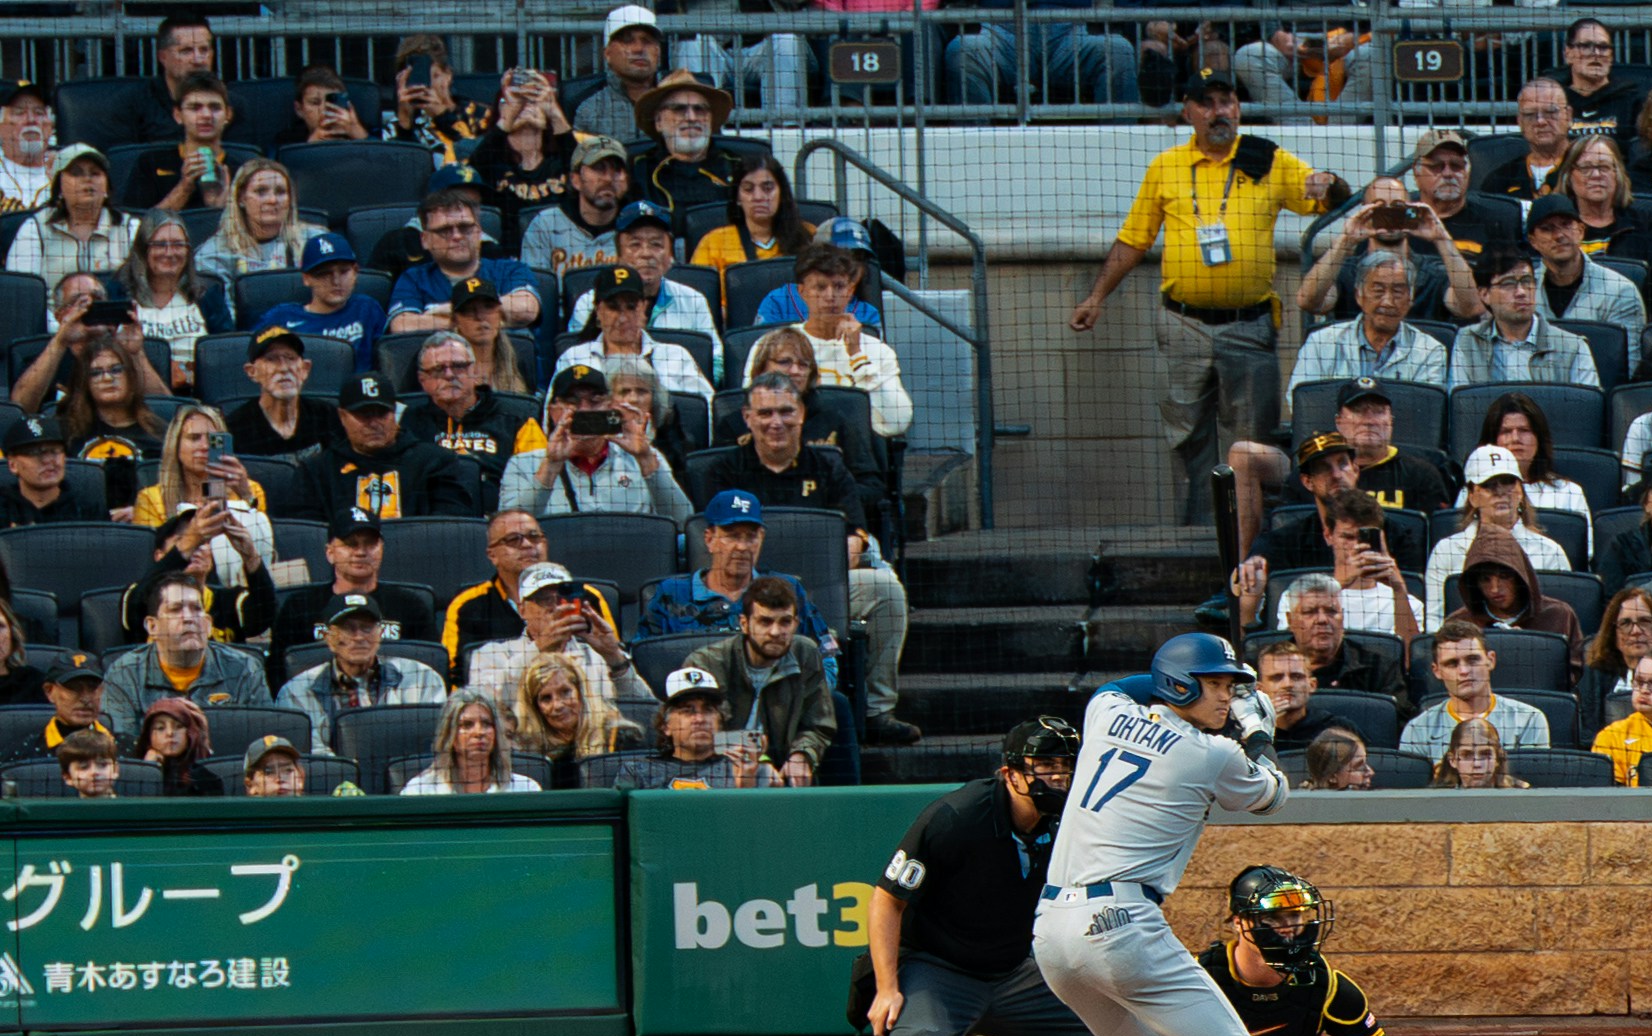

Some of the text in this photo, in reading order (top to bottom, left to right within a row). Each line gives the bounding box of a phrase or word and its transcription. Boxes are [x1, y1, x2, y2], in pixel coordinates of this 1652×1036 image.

[851, 53, 879, 72] 18
[1415, 51, 1442, 70] 19
[467, 278, 480, 292] P
[614, 269, 629, 284] P
[1490, 453, 1501, 466] P
[802, 480, 816, 496] P
[1108, 713, 1182, 754] OHTANI
[1079, 747, 1152, 812] 17
[884, 850, 926, 889] 90
[2, 853, 300, 932] グループ
[43, 956, 291, 993] 青木あすなろ建設
